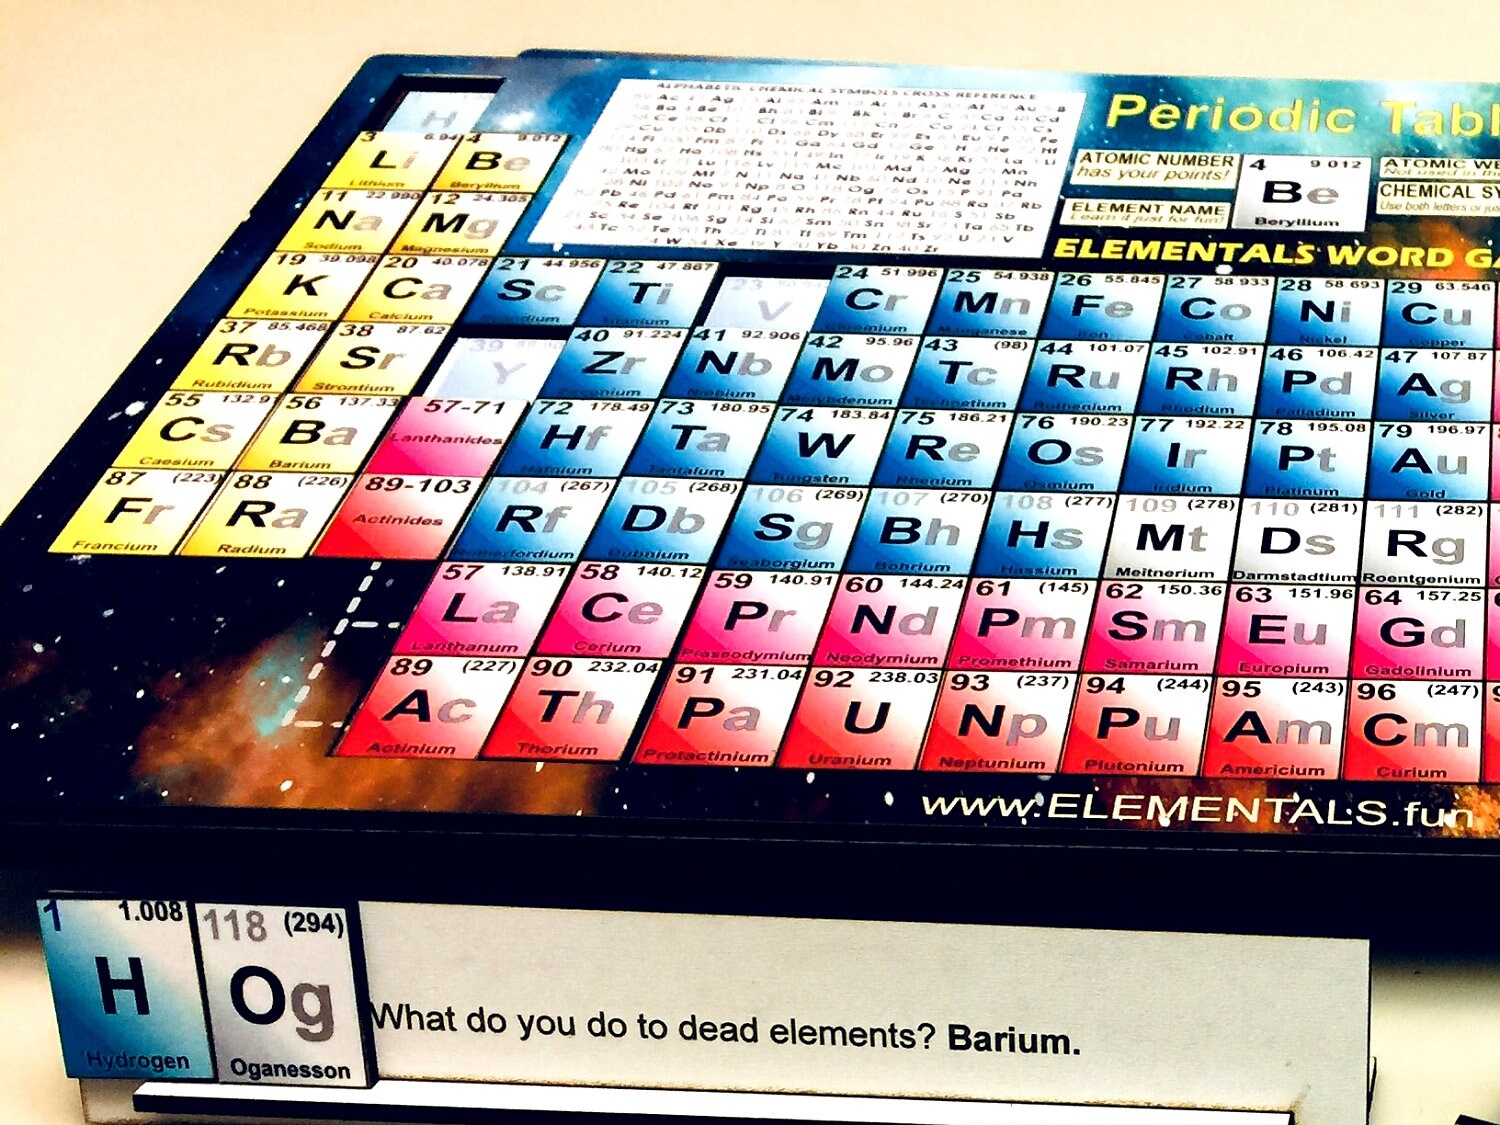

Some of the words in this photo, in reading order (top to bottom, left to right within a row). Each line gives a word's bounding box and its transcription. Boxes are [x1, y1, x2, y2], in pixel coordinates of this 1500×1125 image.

[1106, 94, 1356, 135] Periodic
[1080, 152, 1151, 164] ATOMIC
[1157, 154, 1234, 166] NUMBER
[1249, 159, 1266, 170] 4
[1384, 159, 1466, 168] ATOMIC
[1077, 166, 1111, 178] has
[1118, 169, 1159, 179] your
[1164, 169, 1230, 181] points!
[1262, 181, 1338, 204] Be
[1380, 184, 1475, 198] CHEMICAL
[1072, 202, 1161, 213] ELEMENT
[1170, 204, 1225, 215] NAME
[1380, 201, 1402, 210] Use
[1405, 201, 1429, 210] both
[1433, 202, 1466, 211] letters
[1255, 217, 1339, 227] Beryllium
[1054, 239, 1315, 266] ELEMENTALS
[1328, 242, 1452, 268] WORD
[384, 257, 418, 268] 20
[383, 277, 452, 300] Ca
[369, 312, 433, 320] Calcium
[424, 400, 505, 414] 57-71
[390, 434, 502, 445] Lanthanides
[105, 471, 147, 485] 87
[365, 477, 472, 494] 89-103
[104, 497, 175, 524] Fr
[1188, 499, 1235, 511] (278)
[352, 514, 443, 526] Actinides
[1136, 524, 1208, 552] Mt
[72, 541, 157, 552] Francium
[1116, 568, 1214, 578] Meitnerium
[390, 659, 433, 675] 89
[462, 660, 516, 674] (227)
[1222, 680, 1261, 697] 95
[1292, 682, 1344, 696] (243)
[1357, 684, 1396, 700] 96
[1427, 685, 1479, 699] (247)
[381, 689, 476, 723] Ac
[1223, 711, 1332, 745] Am
[1363, 713, 1469, 747] Cm
[366, 742, 456, 754] Actinium
[1220, 764, 1325, 776] Americium
[1377, 767, 1447, 778] Curium
[920, 792, 1474, 828] www.ELEMENTALS.fun
[43, 900, 62, 932] 1
[118, 901, 183, 922] 1.008
[203, 910, 267, 942] 118
[284, 910, 345, 940] (294)
[95, 956, 151, 1016] H
[230, 966, 335, 1041] Og
[371, 1001, 456, 1034] What
[466, 1006, 506, 1035] do
[518, 1014, 576, 1041] you
[588, 1011, 628, 1039] do
[637, 1014, 669, 1041] to
[678, 1014, 759, 1044] dead
[770, 1019, 936, 1050] elements?
[948, 1024, 1081, 1056] Barium.
[86, 1049, 190, 1073] Hydrogen
[230, 1058, 351, 1082] Oganesson
